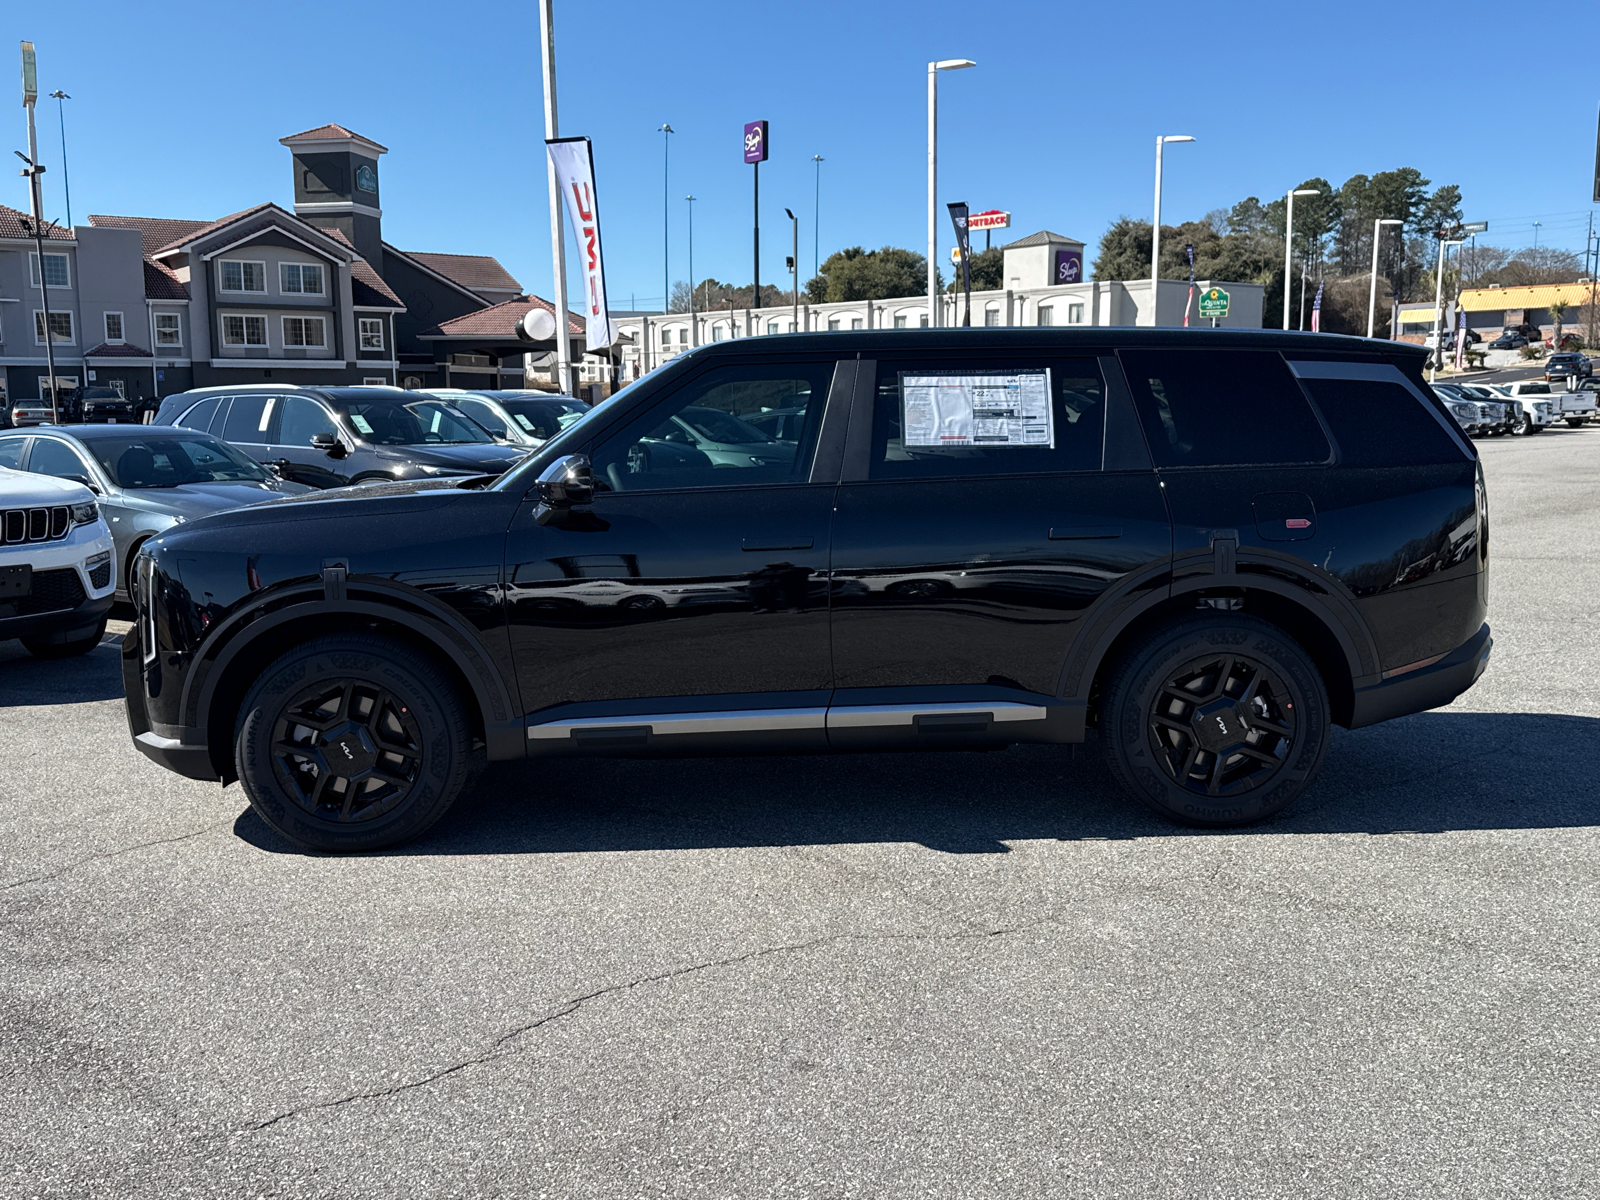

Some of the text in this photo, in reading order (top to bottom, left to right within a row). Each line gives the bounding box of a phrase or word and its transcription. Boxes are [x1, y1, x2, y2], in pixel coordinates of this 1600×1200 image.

[968, 216, 1006, 227] OUTBACK
[1059, 262, 1078, 279] Sleep
[1138, 645, 1182, 695] CRUGEN
[382, 667, 433, 714] CRUGEN
[249, 708, 263, 767] KUMHO
[1184, 804, 1243, 818] KUMHO
